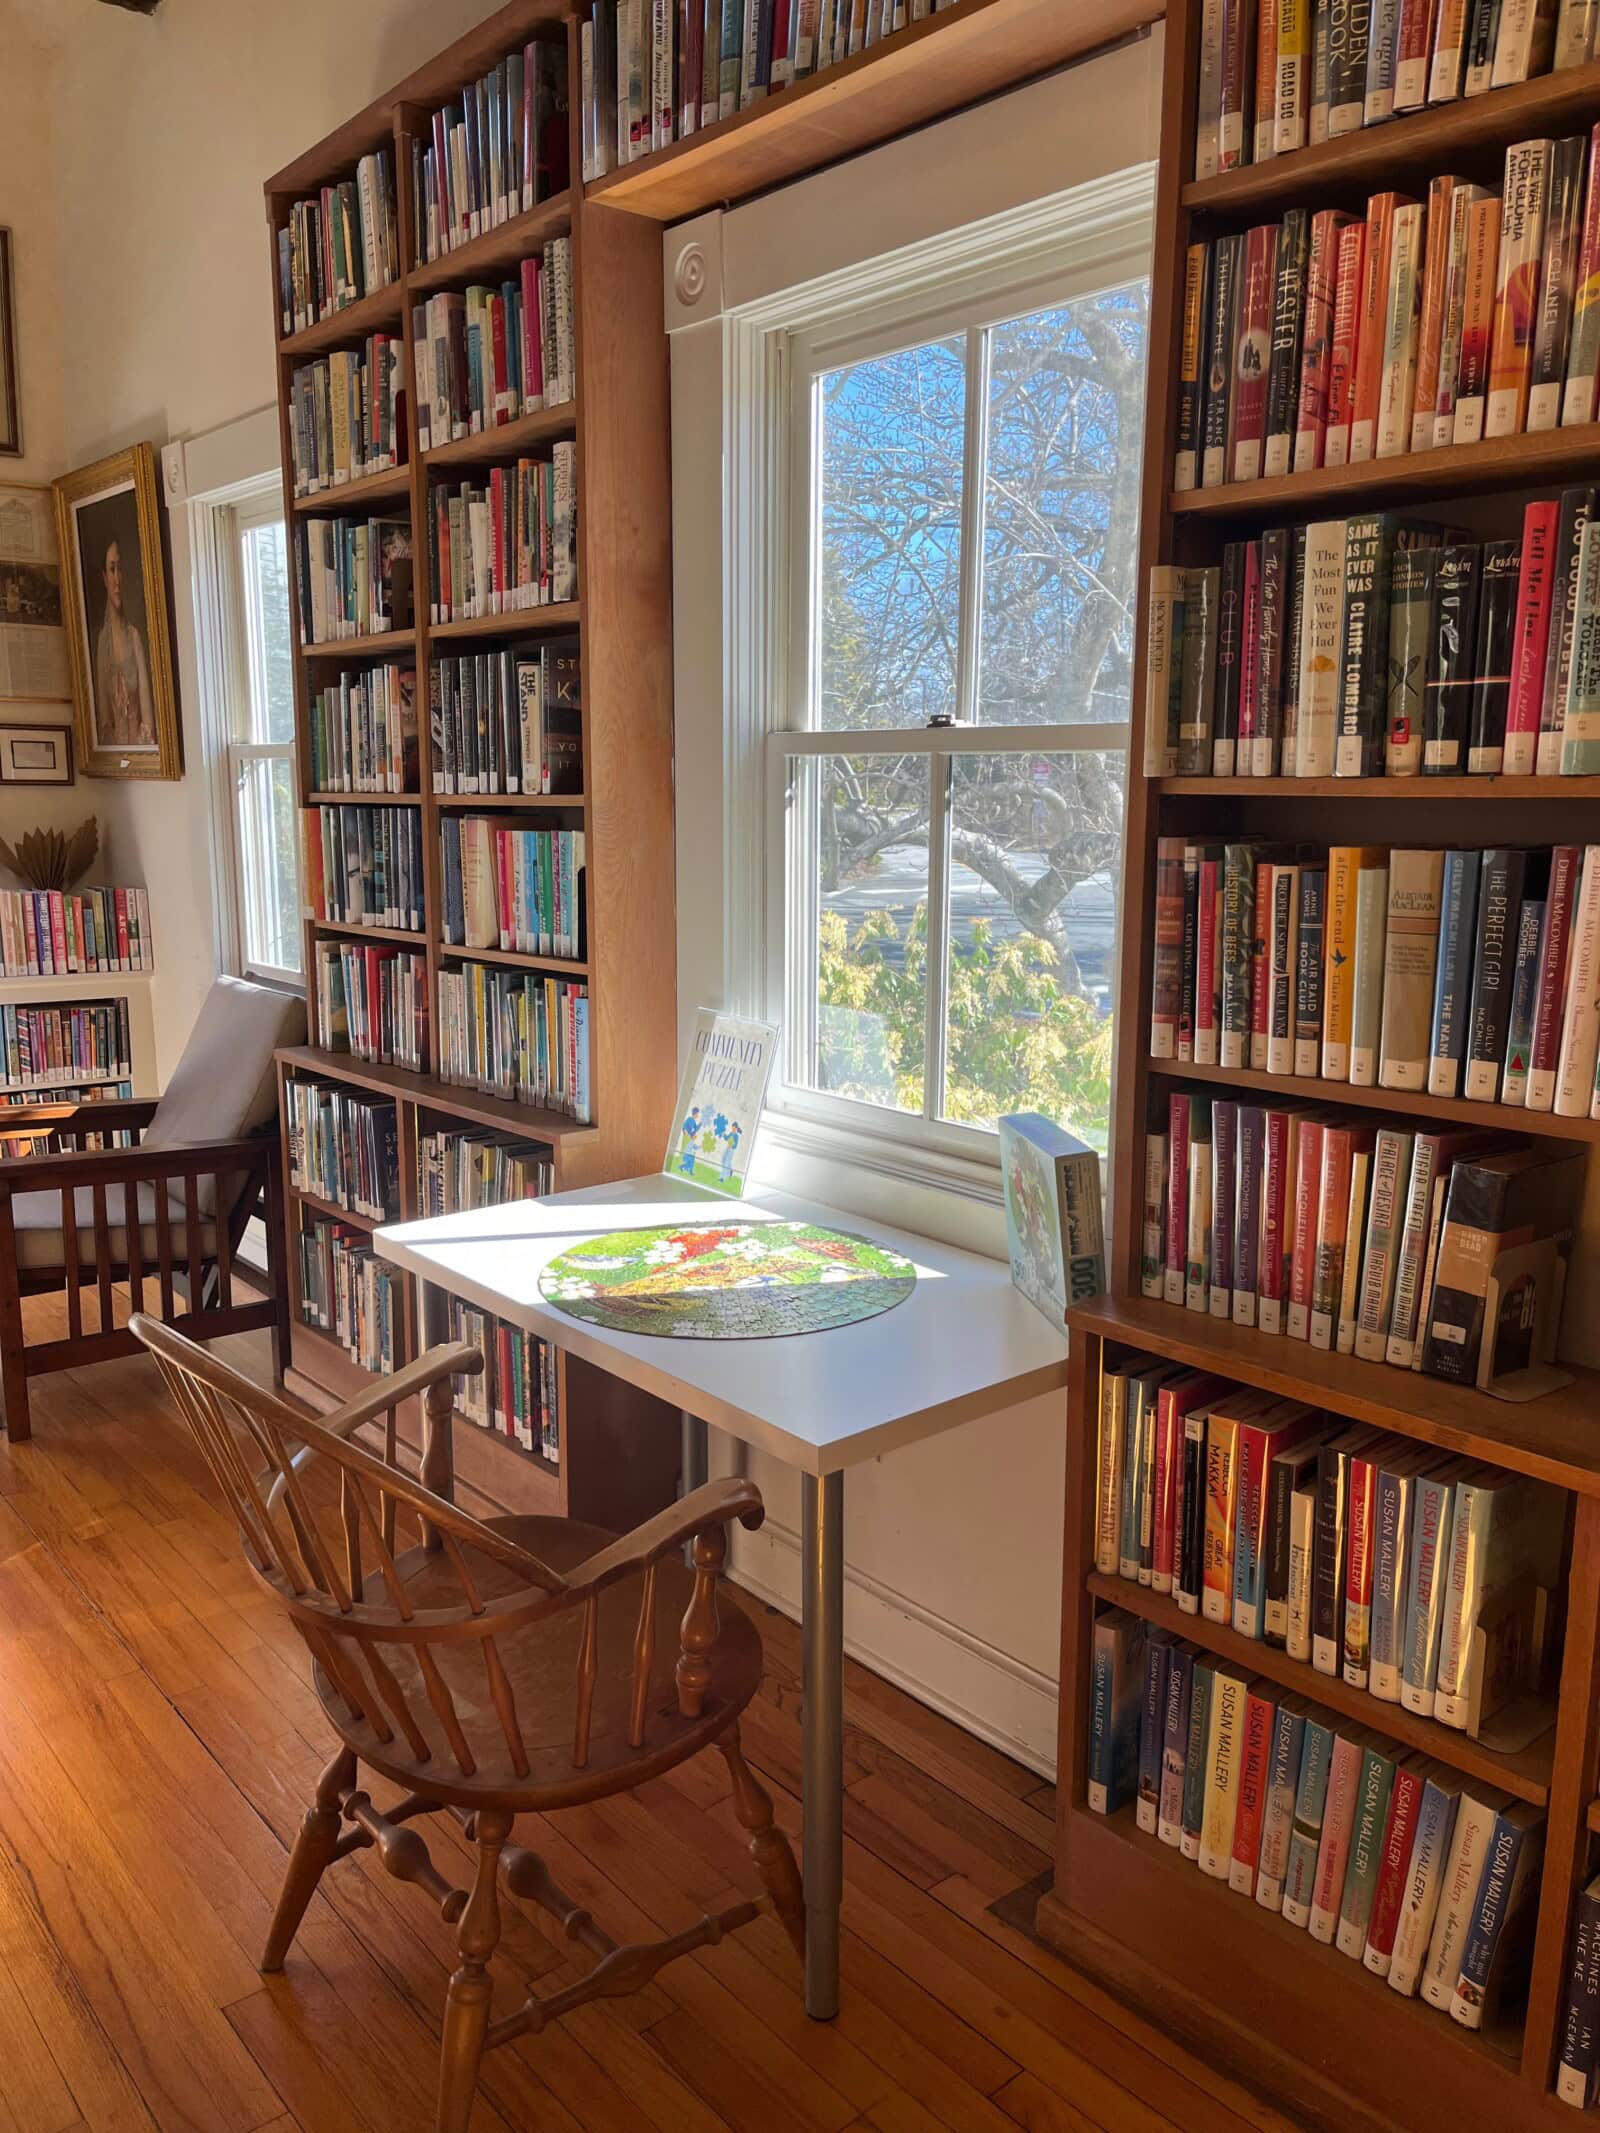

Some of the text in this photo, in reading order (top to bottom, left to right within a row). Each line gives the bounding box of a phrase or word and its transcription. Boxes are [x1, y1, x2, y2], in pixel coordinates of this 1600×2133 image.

[1349, 3, 1368, 66] LDEN
[1281, 62, 1295, 119] ROAD DO
[1516, 150, 1530, 180] FOR
[1273, 268, 1299, 351] HESTER
[1215, 400, 1224, 447] FRANC
[1346, 523, 1379, 540] SAME
[1530, 524, 1546, 560] Tell
[1264, 555, 1277, 576] The
[1312, 568, 1342, 580] Most
[1316, 550, 1339, 561] The
[1346, 560, 1374, 575] EVER
[1314, 585, 1337, 595] Fun
[1346, 578, 1373, 593] WAS
[1527, 567, 1543, 594] Me
[1314, 602, 1335, 613] We
[527, 672, 535, 696] THE
[1343, 602, 1364, 735] CLAIRE LOMBARD
[1334, 856, 1346, 889] after
[1489, 869, 1507, 891] THE
[1554, 859, 1569, 900] DEBBIE
[1334, 893, 1345, 915] the
[1484, 896, 1507, 957] PERFECT
[1333, 920, 1345, 944] end
[1527, 919, 1539, 957] DEBBIE
[1547, 902, 1564, 969] MACOMBER
[1298, 941, 1308, 1011] BOOK CLUB
[1307, 959, 1318, 1012] AIR RAID
[1441, 994, 1453, 1019] THE
[695, 1031, 763, 1067] COMMUNITY
[1472, 1007, 1486, 1061] MACMILLA
[1485, 1025, 1496, 1055] GILLY
[701, 1062, 744, 1091] PUZZLE
[1241, 1128, 1252, 1220] DEBBIE MACOMBER
[1380, 1142, 1397, 1180] PALACE
[1208, 1444, 1221, 1498] MAKKAI
[1351, 1499, 1365, 1592] SUSAN MALLERY
[1379, 1488, 1395, 1600] SUSAN MALLERY
[1417, 1488, 1438, 1606] SUSAN MALLERY
[1094, 1652, 1106, 1737] SUSAN MALLERY
[1148, 1651, 1158, 1716] SUSAN MALLERY
[1167, 1668, 1180, 1735] SUSAN MALLERY
[1214, 1683, 1236, 1792] SUSAN MALLERY
[1248, 1703, 1265, 1749] SUSAN
[1277, 1715, 1292, 1762] SUSAN
[1242, 1752, 1260, 1813] MALLERY
[1303, 1730, 1321, 1817] SUSAN MALLERY
[1354, 1760, 1381, 1878] SUSAN MALLERY
[1386, 1775, 1413, 1871] SUSAN MALLERY
[1411, 1842, 1431, 1903] MALLERY
[1449, 1821, 1480, 1905] Susan Mallery
[1491, 1831, 1513, 1877] SUSAN
[1479, 1879, 1505, 1936] MALLERY
[1476, 1961, 1485, 1977] not
[1573, 1922, 1588, 1983] LIKE ME
[1580, 2024, 1592, 2051] IAN
